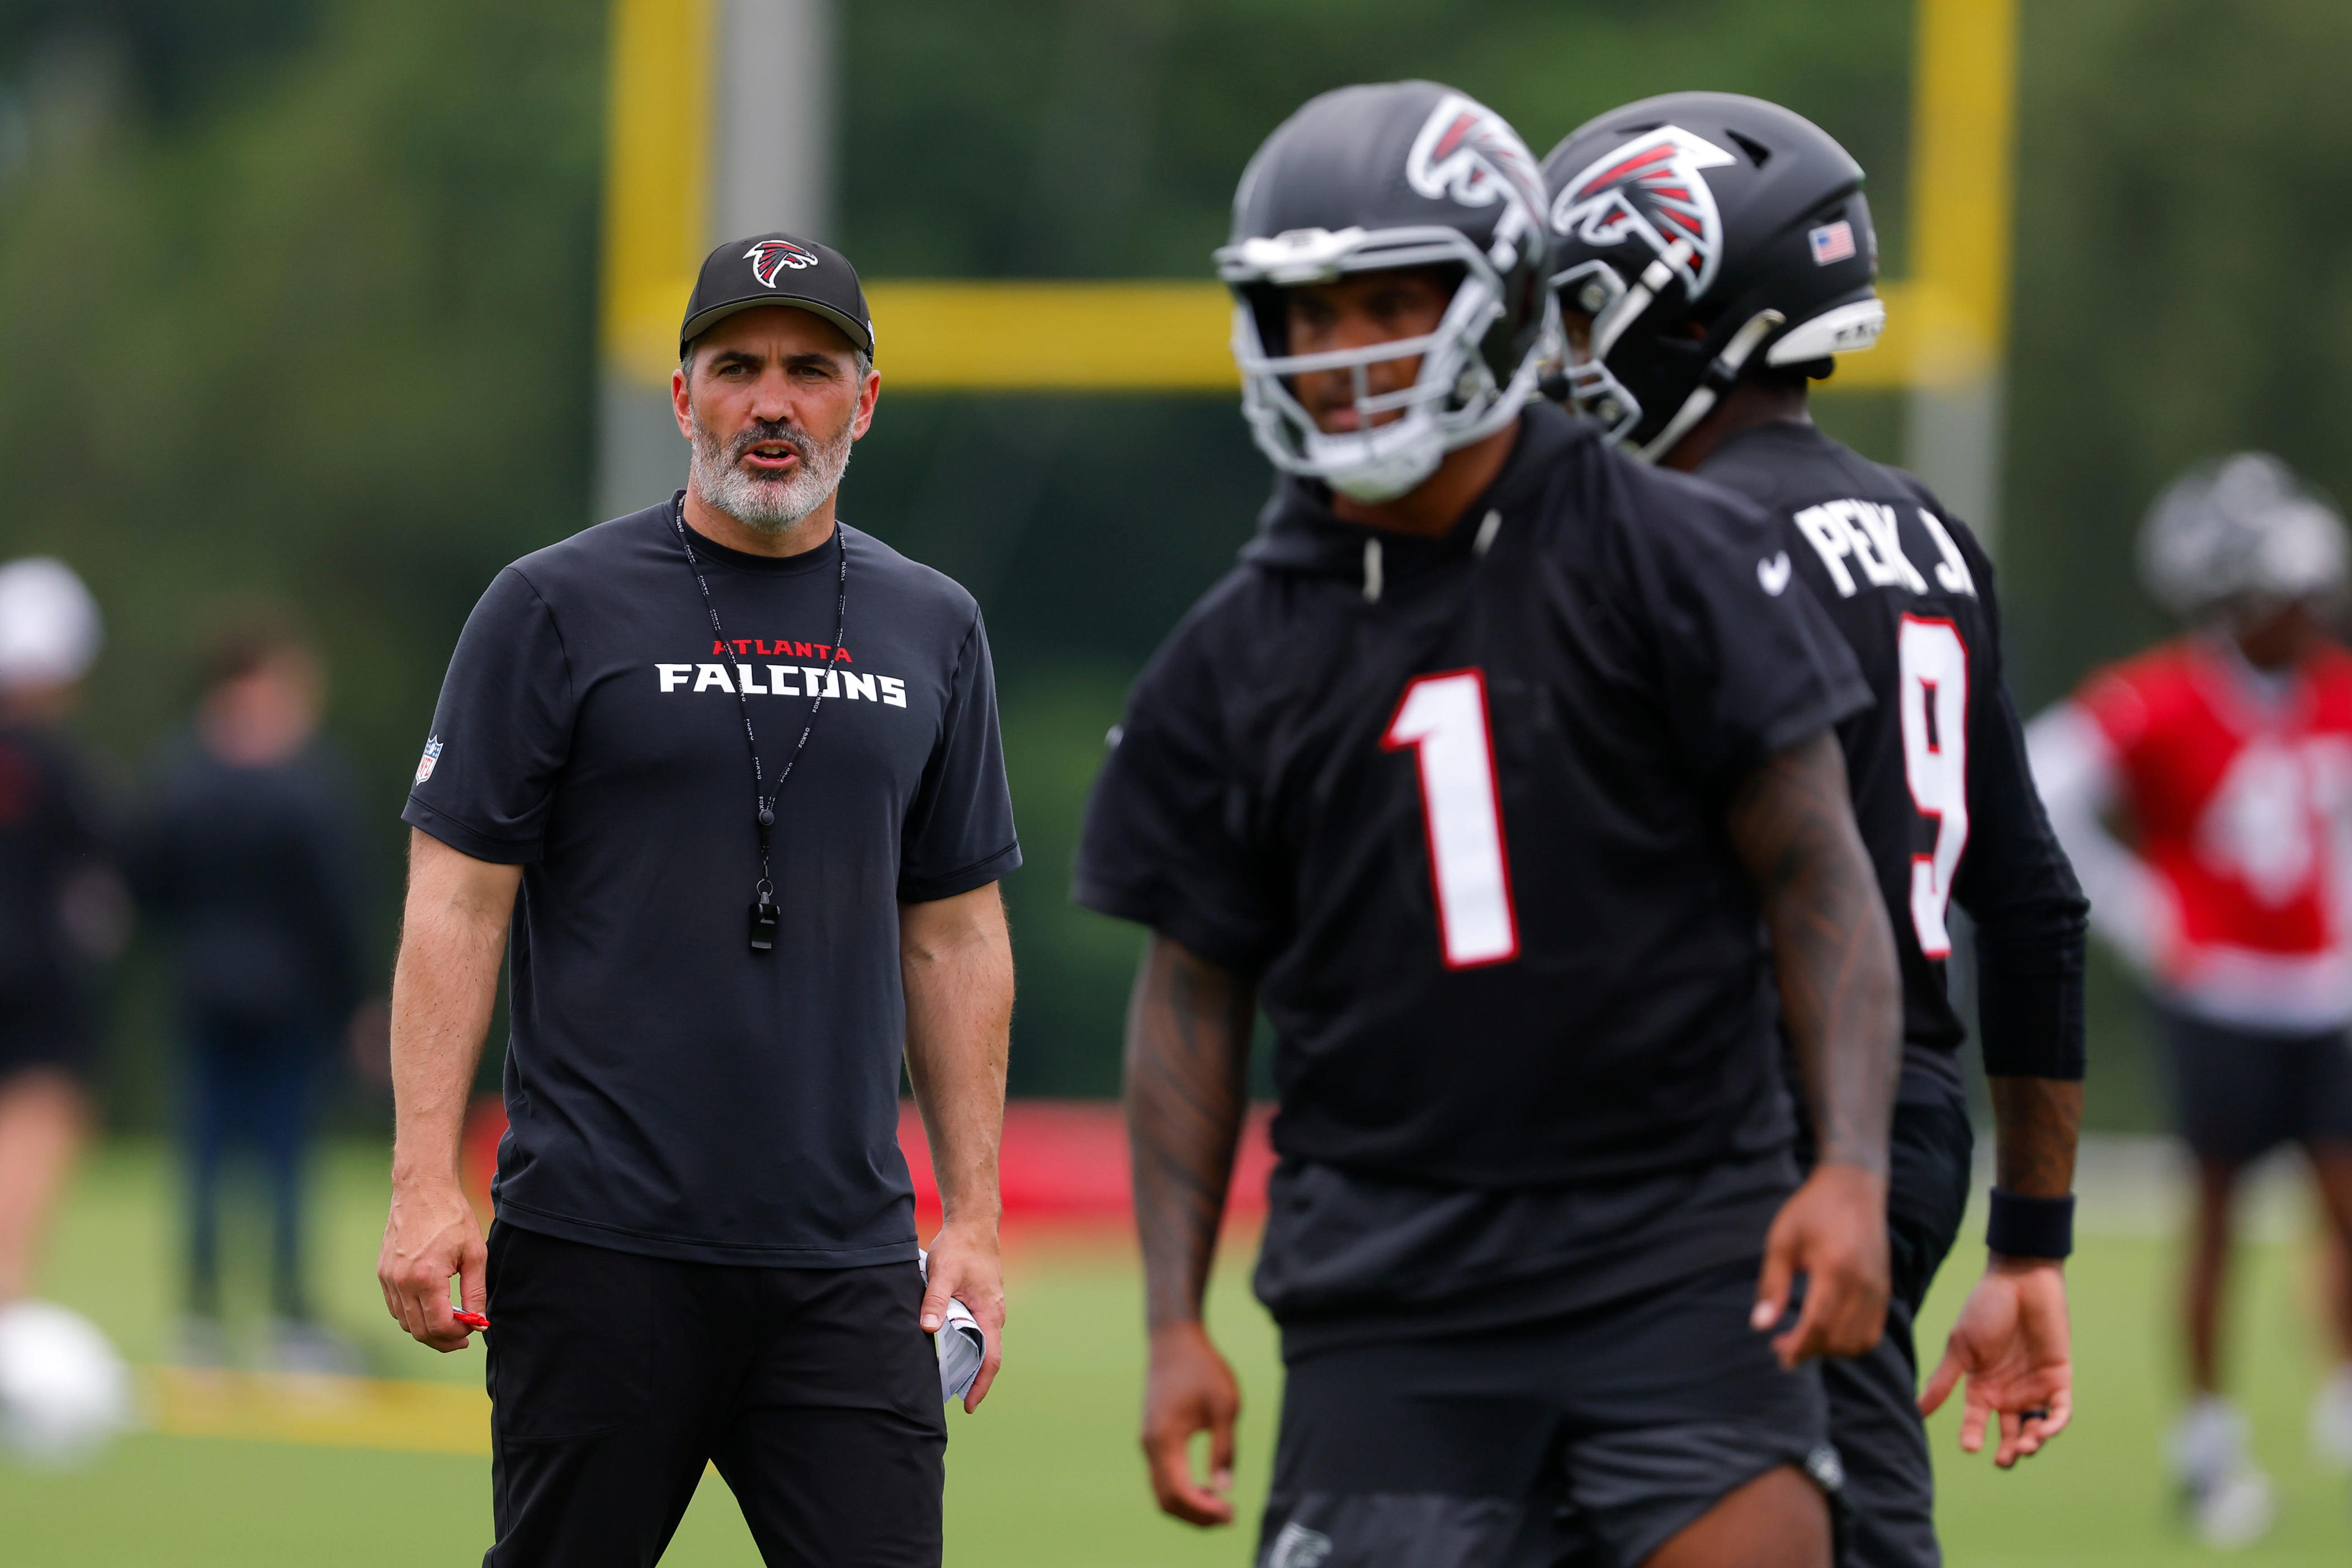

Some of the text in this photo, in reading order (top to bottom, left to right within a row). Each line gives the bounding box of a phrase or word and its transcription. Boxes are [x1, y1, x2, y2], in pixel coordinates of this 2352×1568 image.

[654, 663, 906, 708] FALCONS
[712, 640, 853, 663] ATLANTA
[1377, 665, 1521, 972] 1
[1898, 610, 1971, 960] 9
